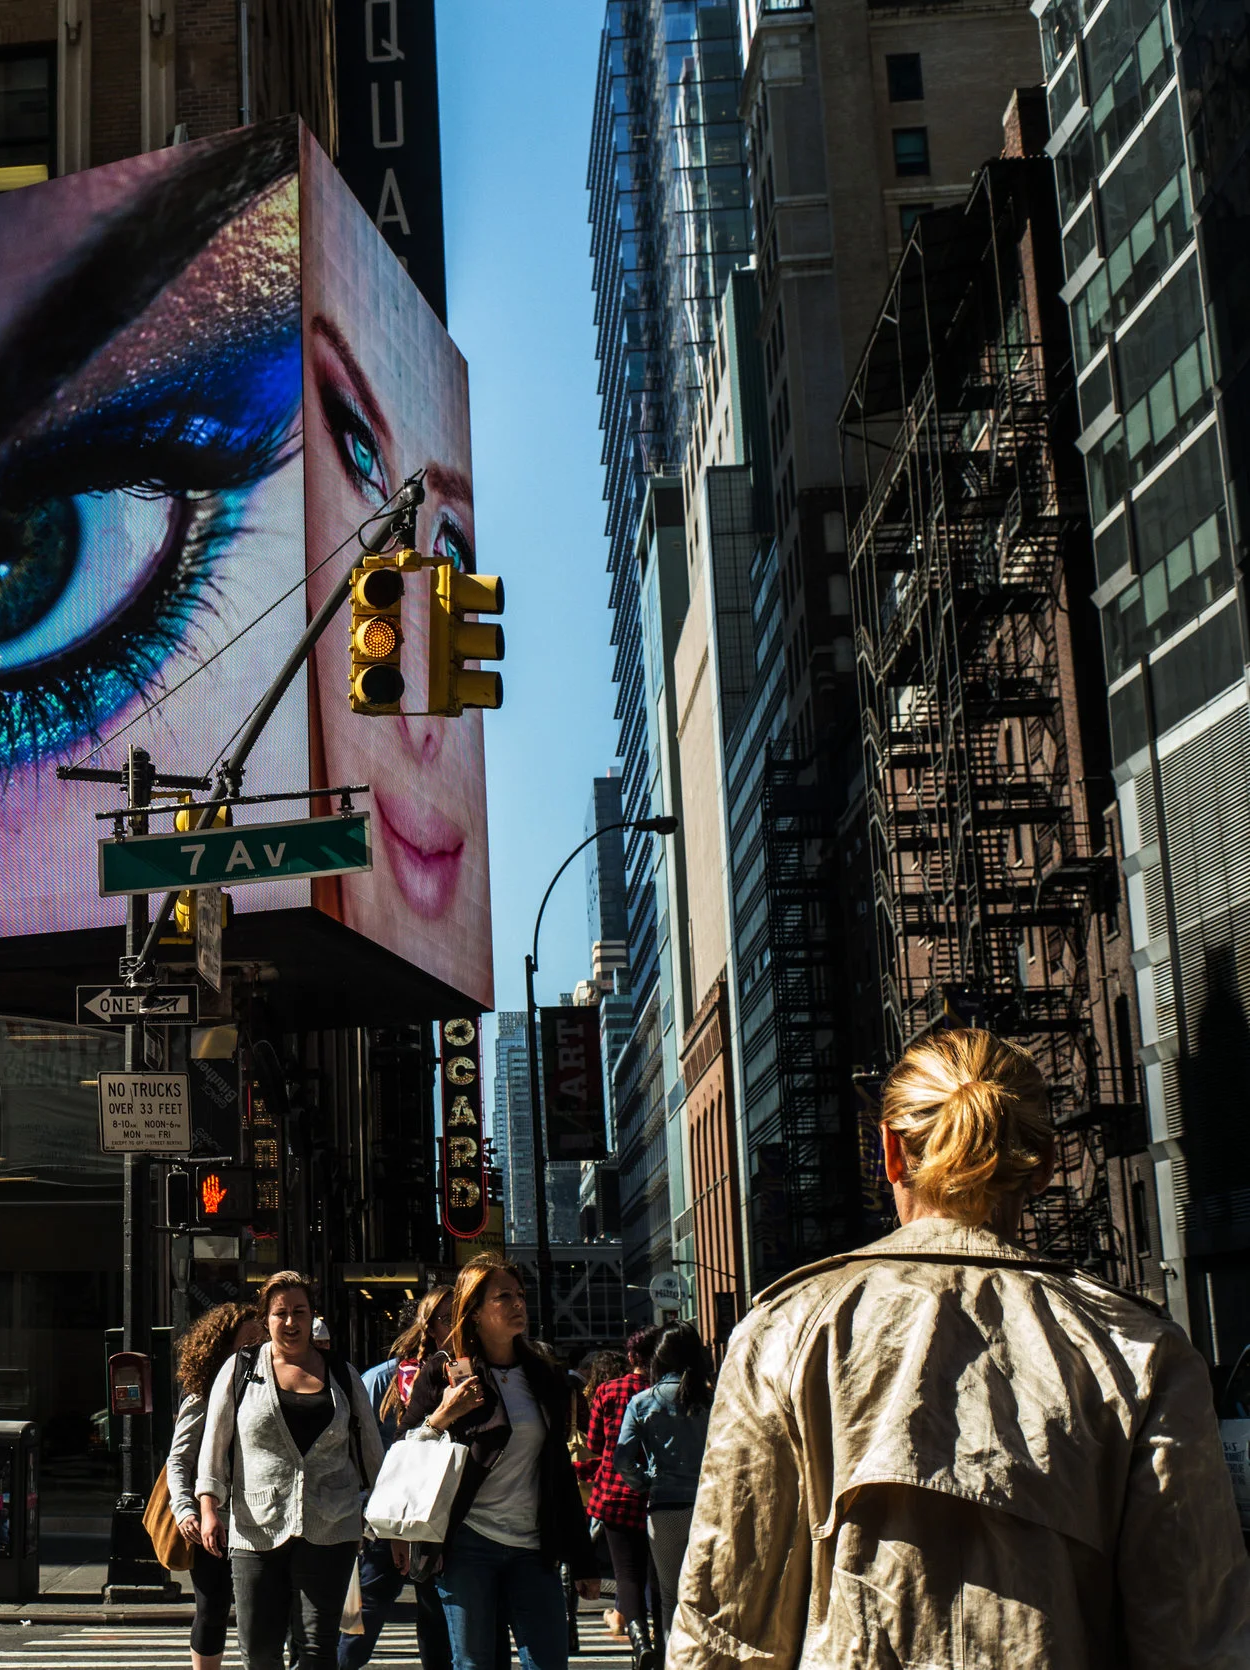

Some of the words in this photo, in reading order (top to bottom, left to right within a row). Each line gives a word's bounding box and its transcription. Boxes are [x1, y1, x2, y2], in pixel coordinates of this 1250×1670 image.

[364, 0, 412, 261] QUA
[180, 843, 206, 876] 7
[100, 998, 135, 1013] ONE
[555, 1018, 586, 1101] ART
[108, 1082, 125, 1097] NO
[131, 1082, 181, 1097] TRUCKS
[109, 1103, 134, 1114] OVER
[140, 1103, 153, 1114] 33
[159, 1103, 182, 1114] FEET
[123, 1130, 141, 1139] MON
[158, 1130, 171, 1139] FRI
